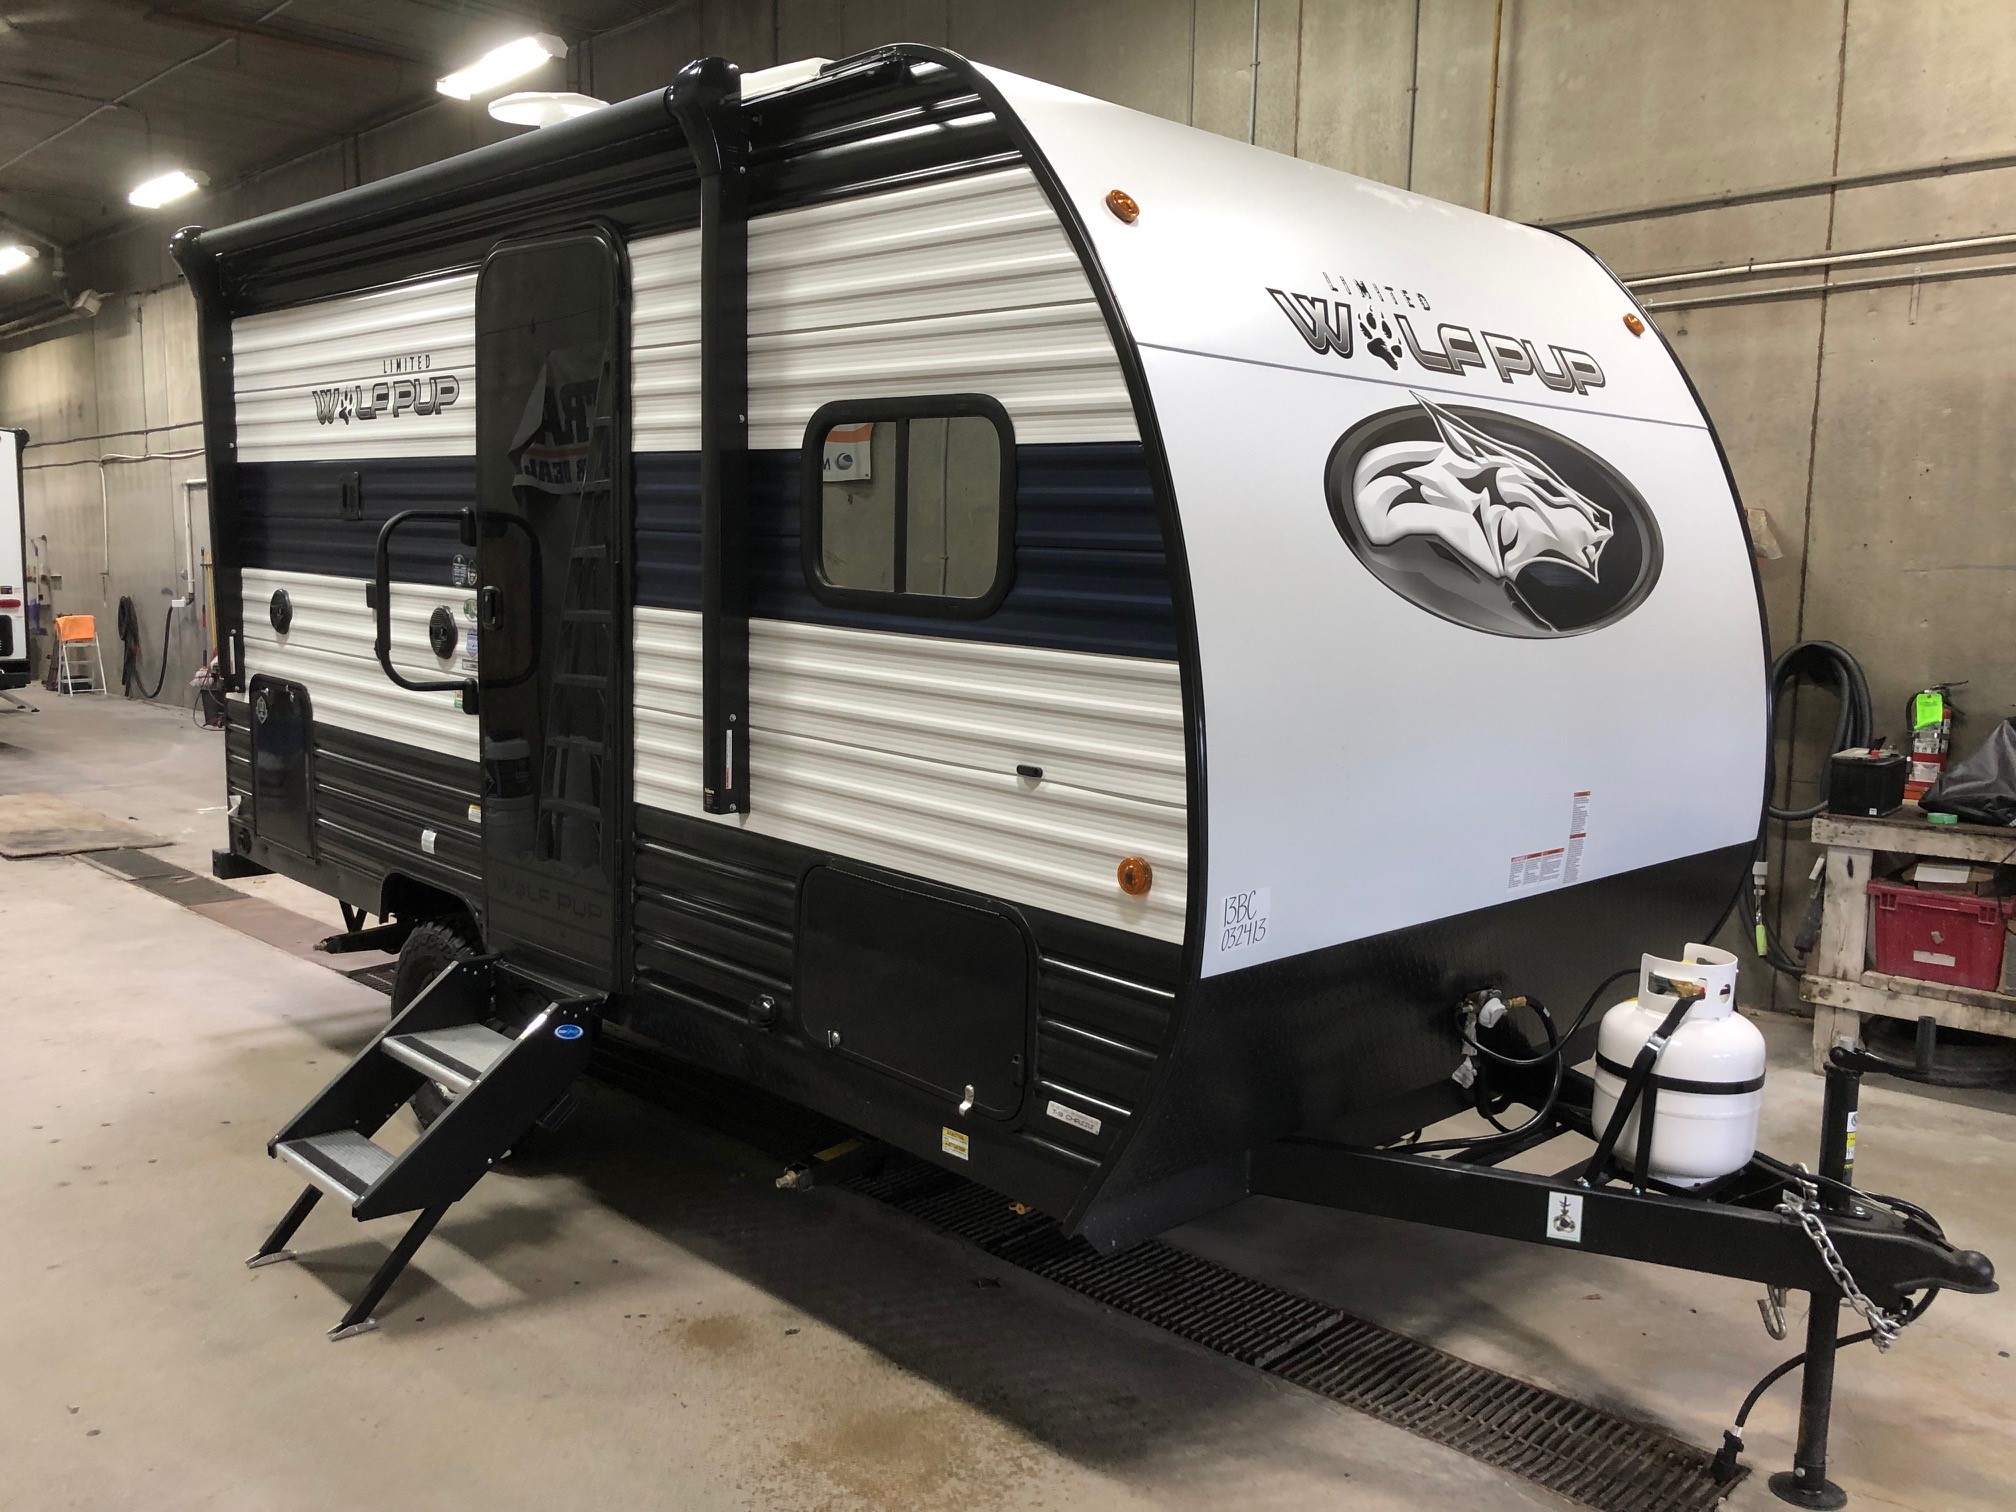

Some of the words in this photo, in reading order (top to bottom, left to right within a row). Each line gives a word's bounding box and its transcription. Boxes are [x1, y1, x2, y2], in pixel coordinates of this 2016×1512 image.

[1322, 272, 1431, 311] LIMITED
[383, 354, 431, 374] LIMITED
[1224, 890, 1257, 927] 13BC
[1221, 918, 1266, 951] 032413
